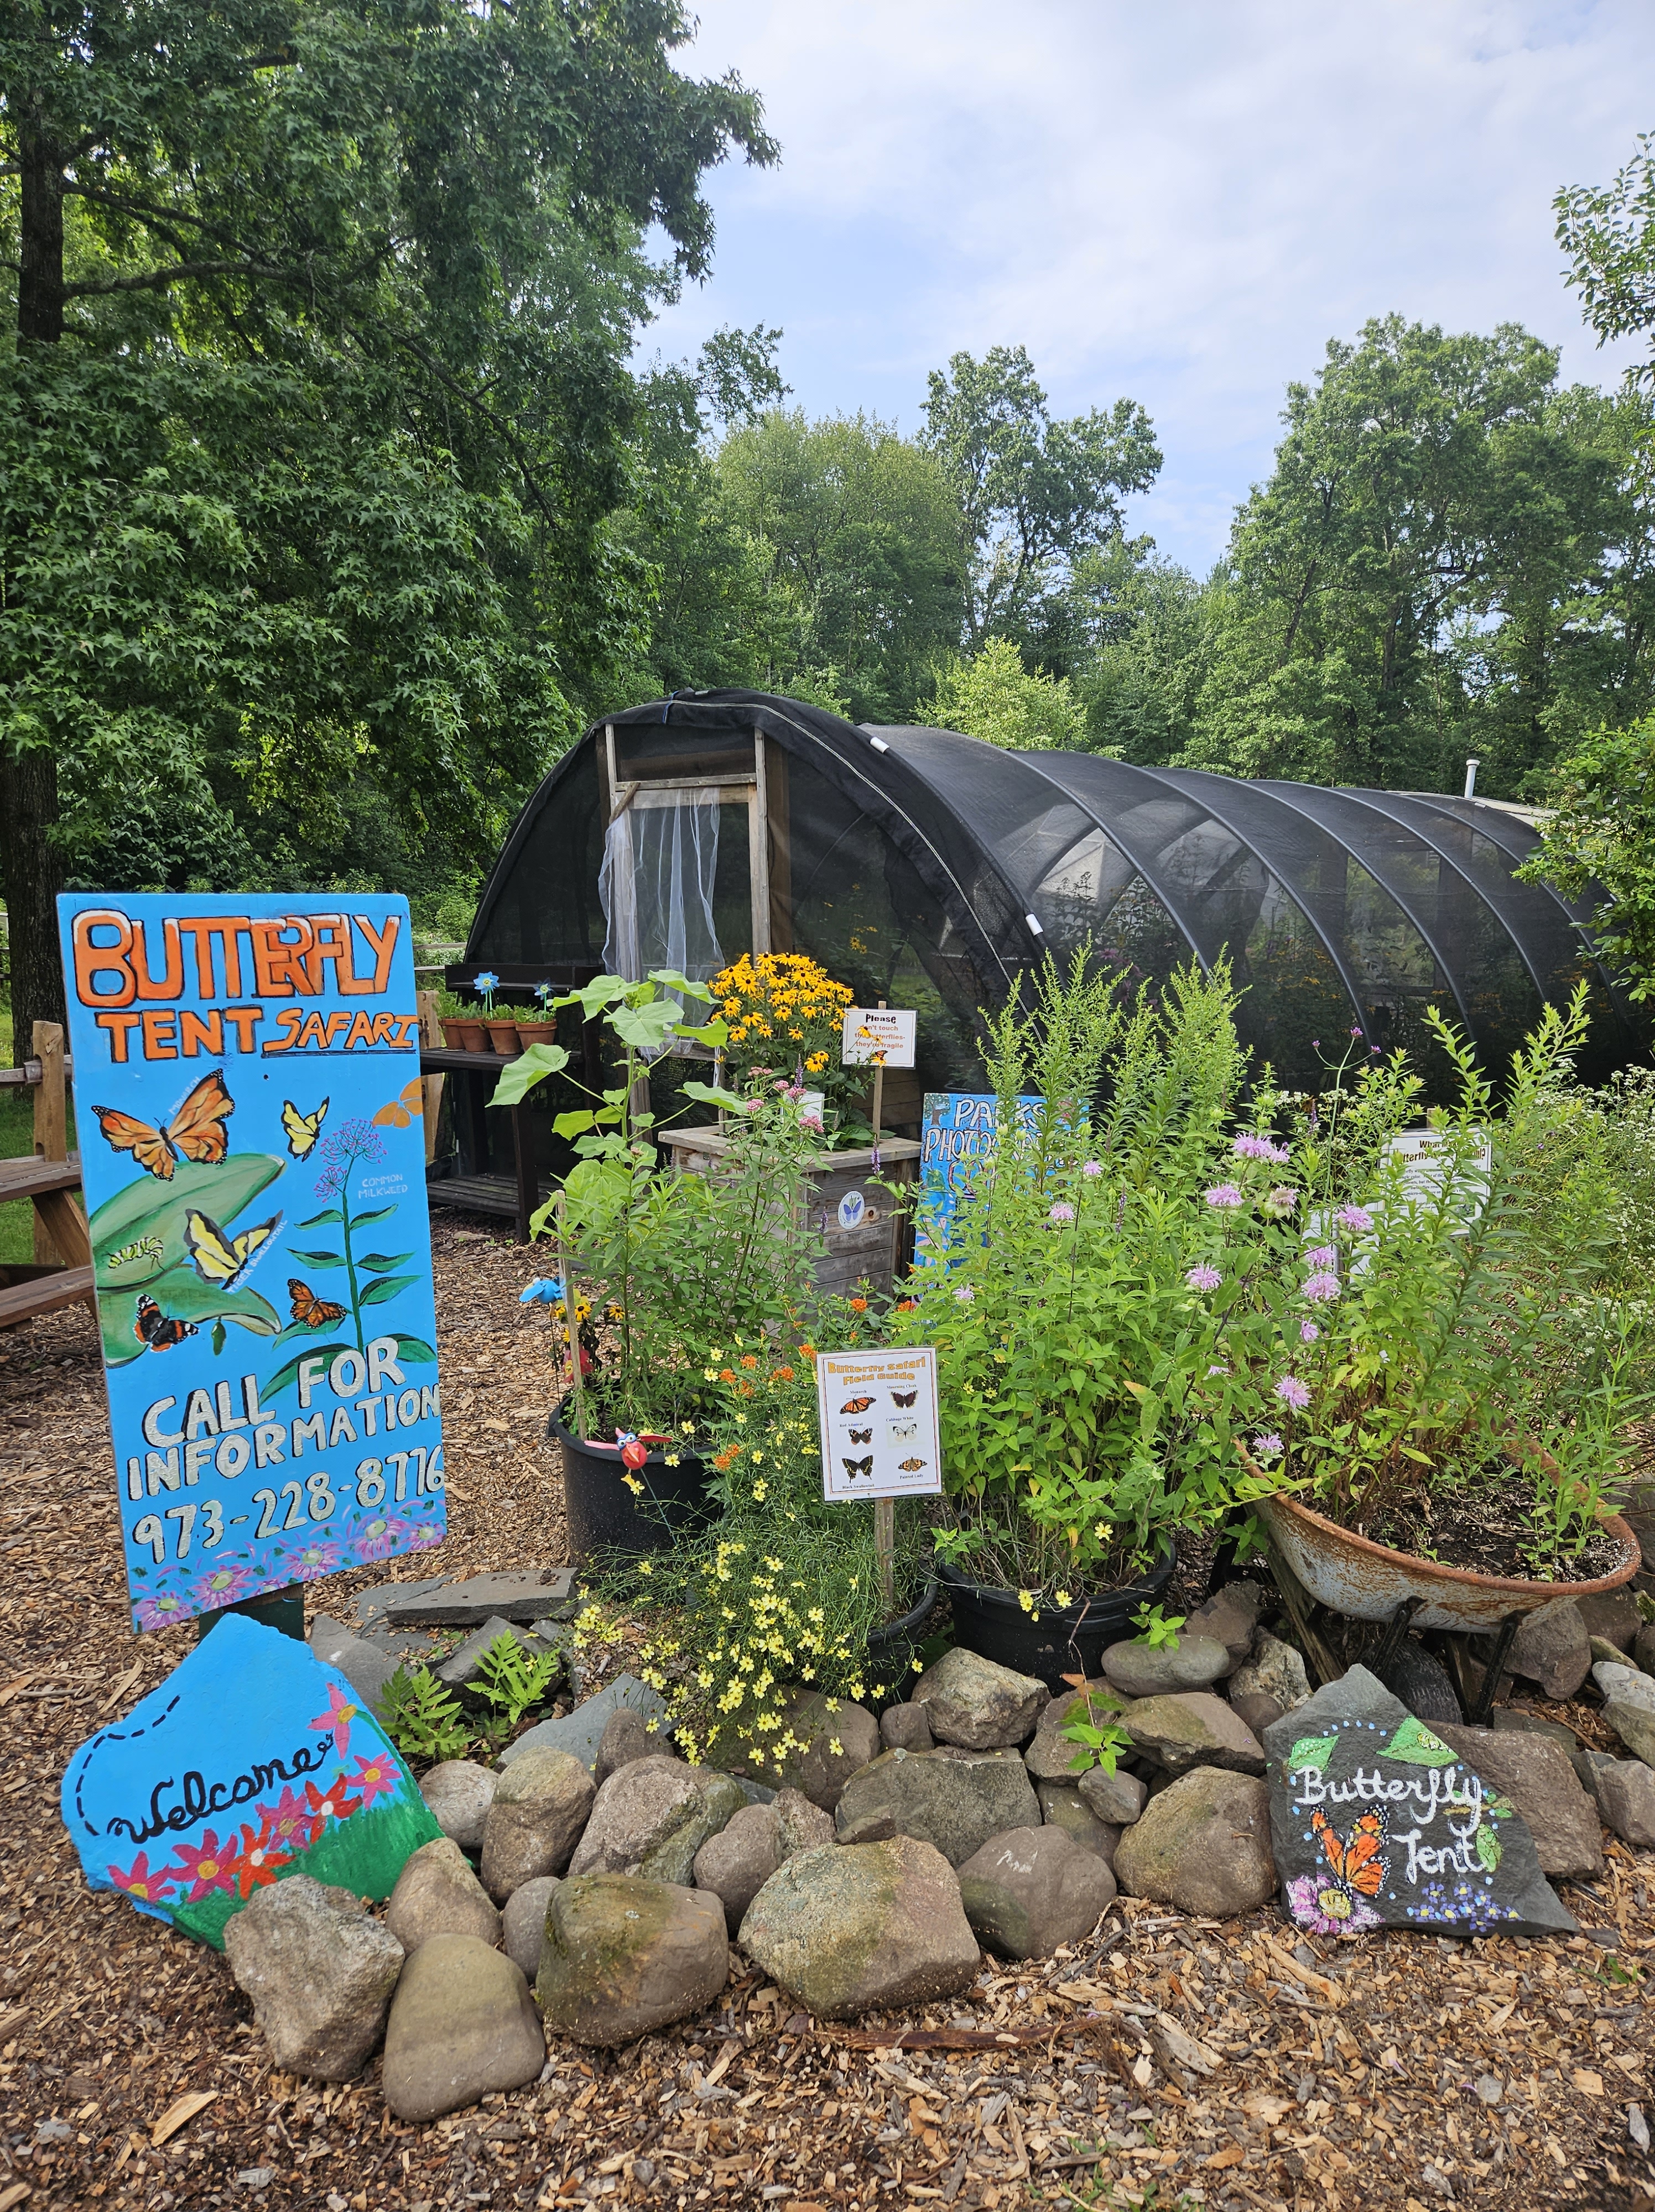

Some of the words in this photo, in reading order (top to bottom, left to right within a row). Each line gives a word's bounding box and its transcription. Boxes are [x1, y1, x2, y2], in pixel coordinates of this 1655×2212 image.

[72, 908, 402, 1008] BUTTERFLY
[96, 1005, 264, 1063] TENT
[262, 1008, 418, 1052] SAFARI
[866, 1013, 896, 1024] Please
[358, 1185, 408, 1199] MILKWEED
[362, 1174, 403, 1187] COMMON
[227, 1269, 254, 1293] TIGER
[249, 1220, 288, 1267] SWALLOWTAIL
[142, 1374, 275, 1448] CALL
[298, 1337, 406, 1408] FOR
[828, 1361, 884, 1374] Butterfly
[843, 1374, 875, 1385] Field
[877, 1371, 915, 1380] Guide
[127, 1384, 440, 1500] INFORMATION
[132, 1444, 444, 1564] 973-228-8776
[1295, 1765, 1482, 1835] Butterfly
[1392, 1825, 1486, 1885] Tent
